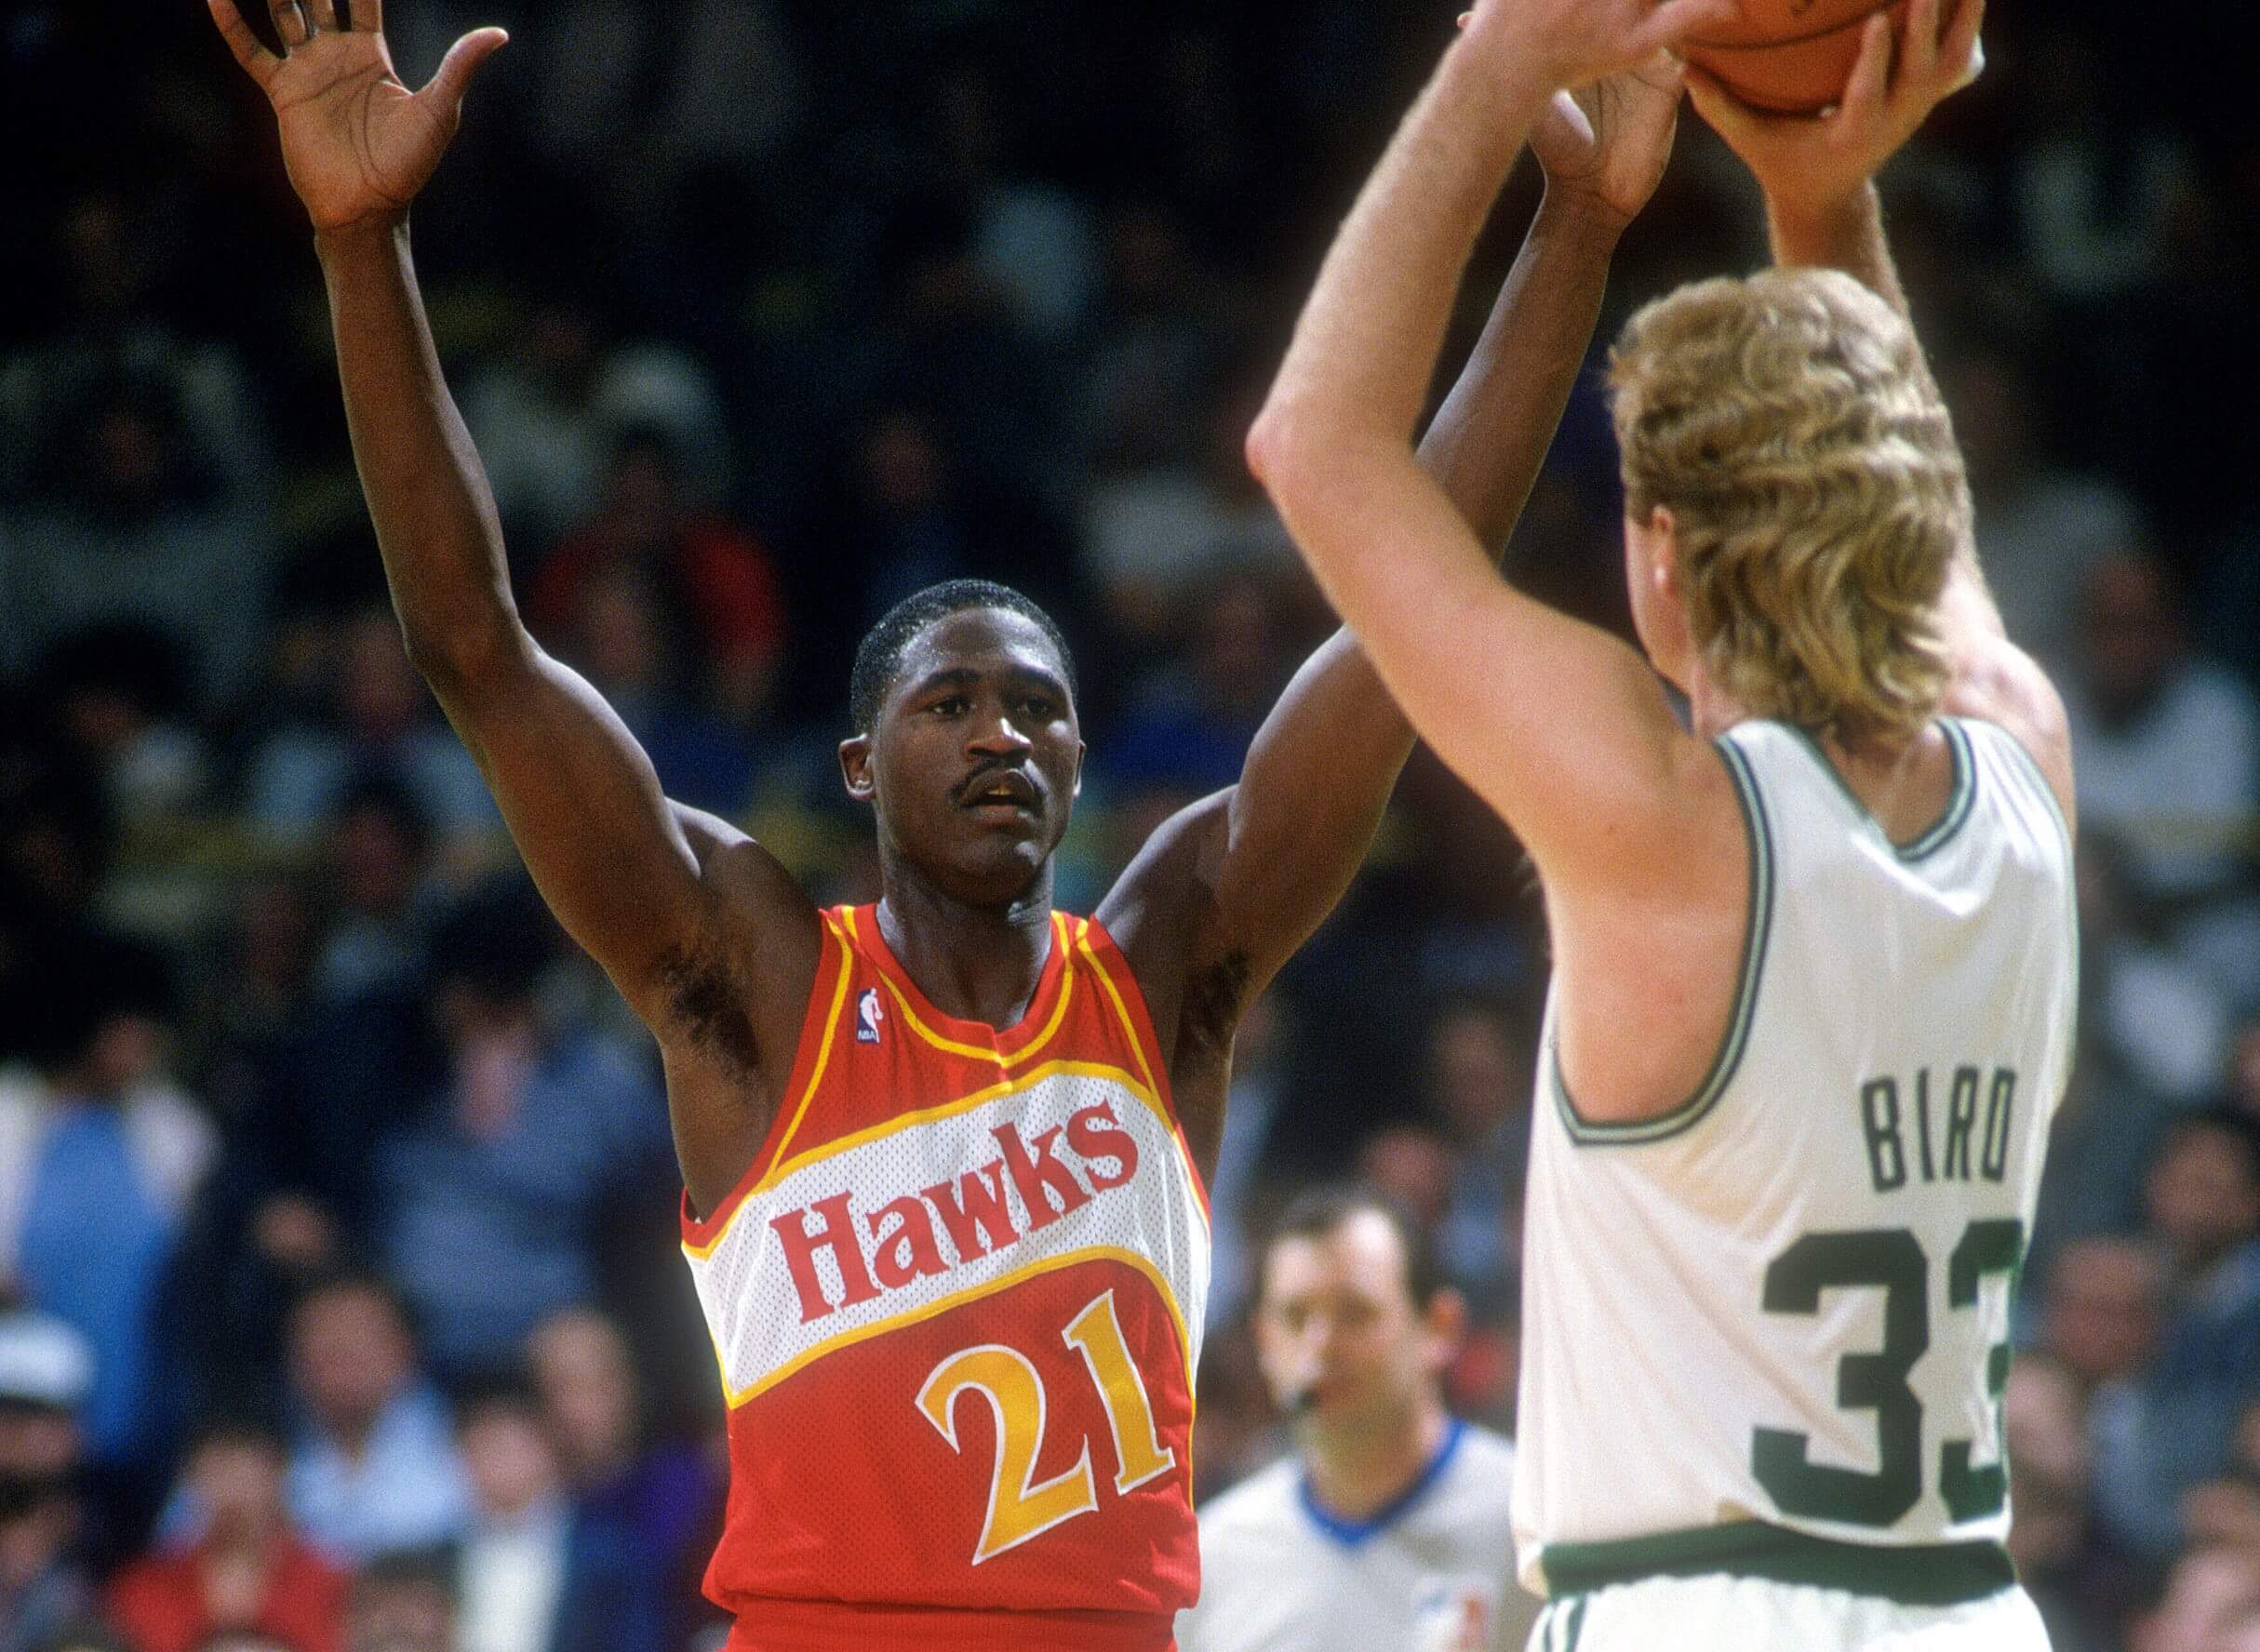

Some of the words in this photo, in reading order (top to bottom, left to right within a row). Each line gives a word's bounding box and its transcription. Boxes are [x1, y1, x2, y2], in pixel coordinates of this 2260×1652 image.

[858, 1030, 876, 1040] NBA
[769, 1099, 1138, 1325] Hawks
[1862, 1065, 2016, 1192] BIRD
[916, 1288, 1175, 1566] 21
